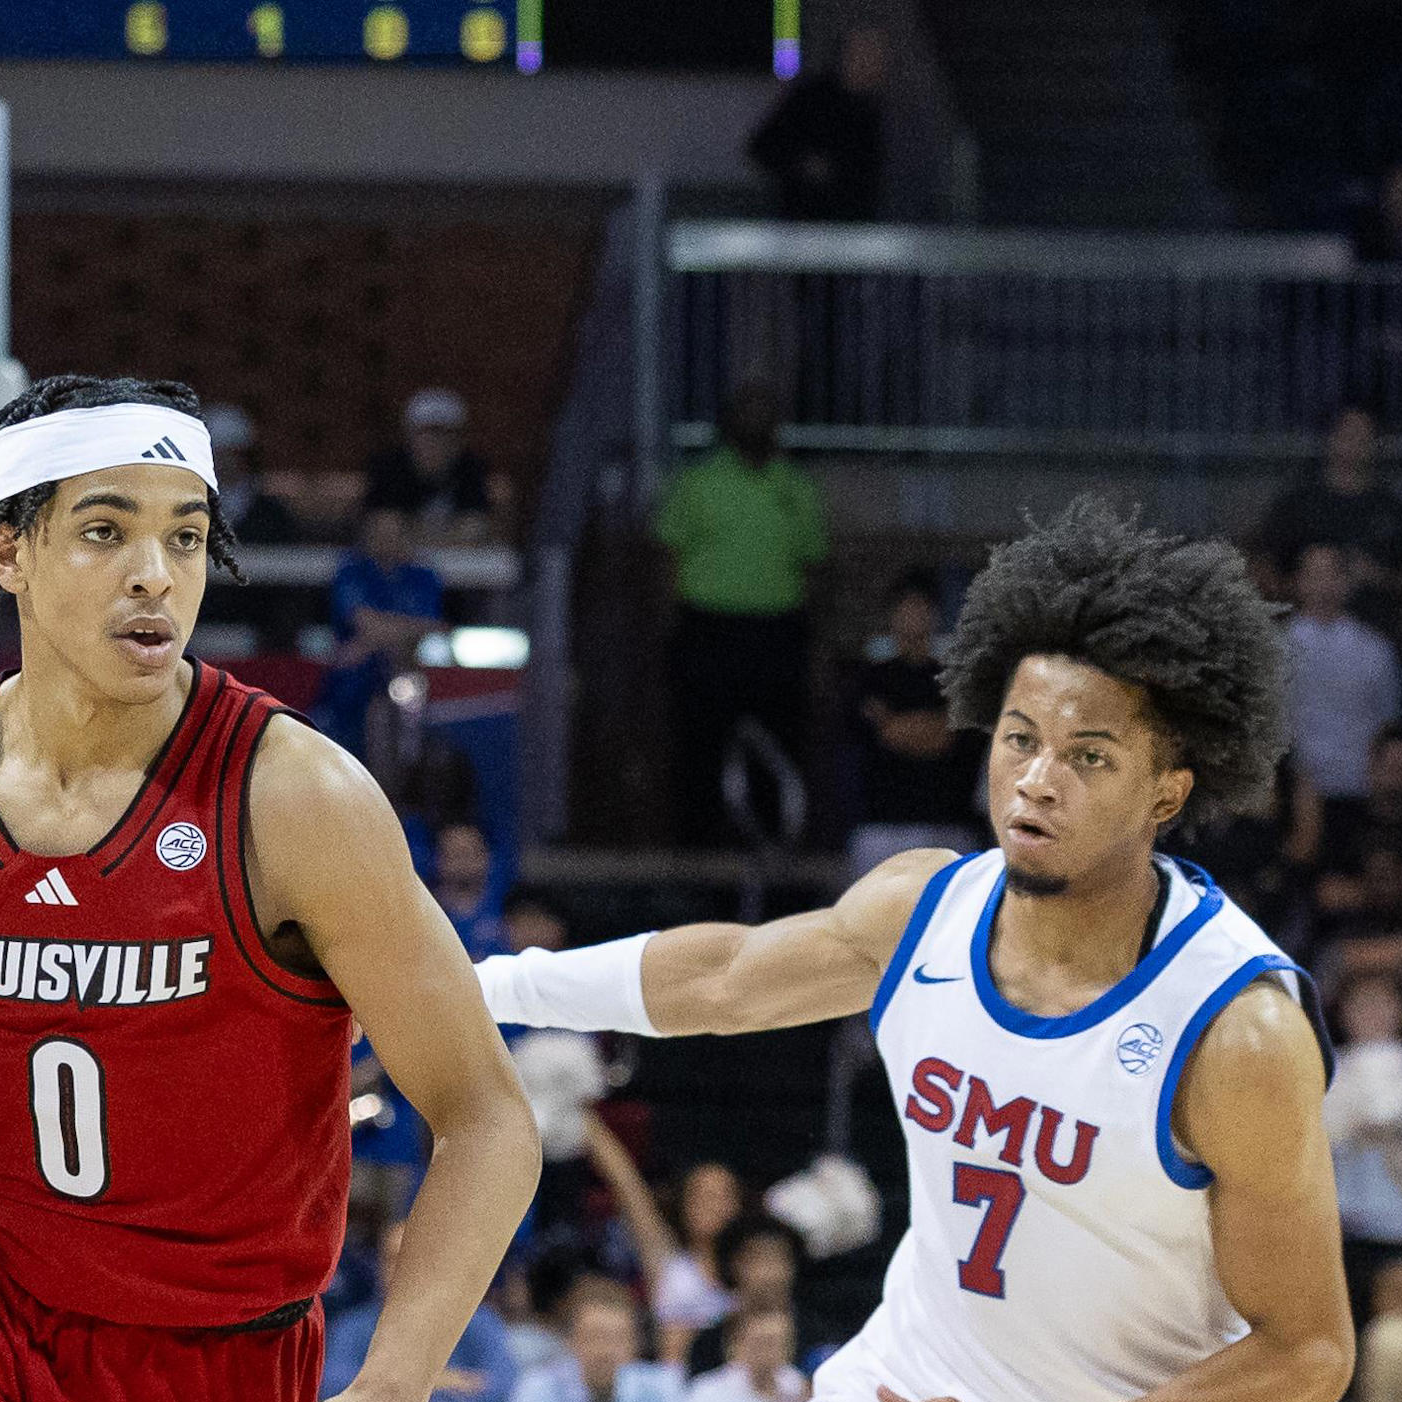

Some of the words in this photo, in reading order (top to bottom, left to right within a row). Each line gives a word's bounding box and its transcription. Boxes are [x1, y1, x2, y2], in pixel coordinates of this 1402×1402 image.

[164, 838, 203, 851] ACC
[29, 1037, 110, 1202] 0
[905, 1056, 1100, 1185] SMU
[952, 1161, 1028, 1299] 7
